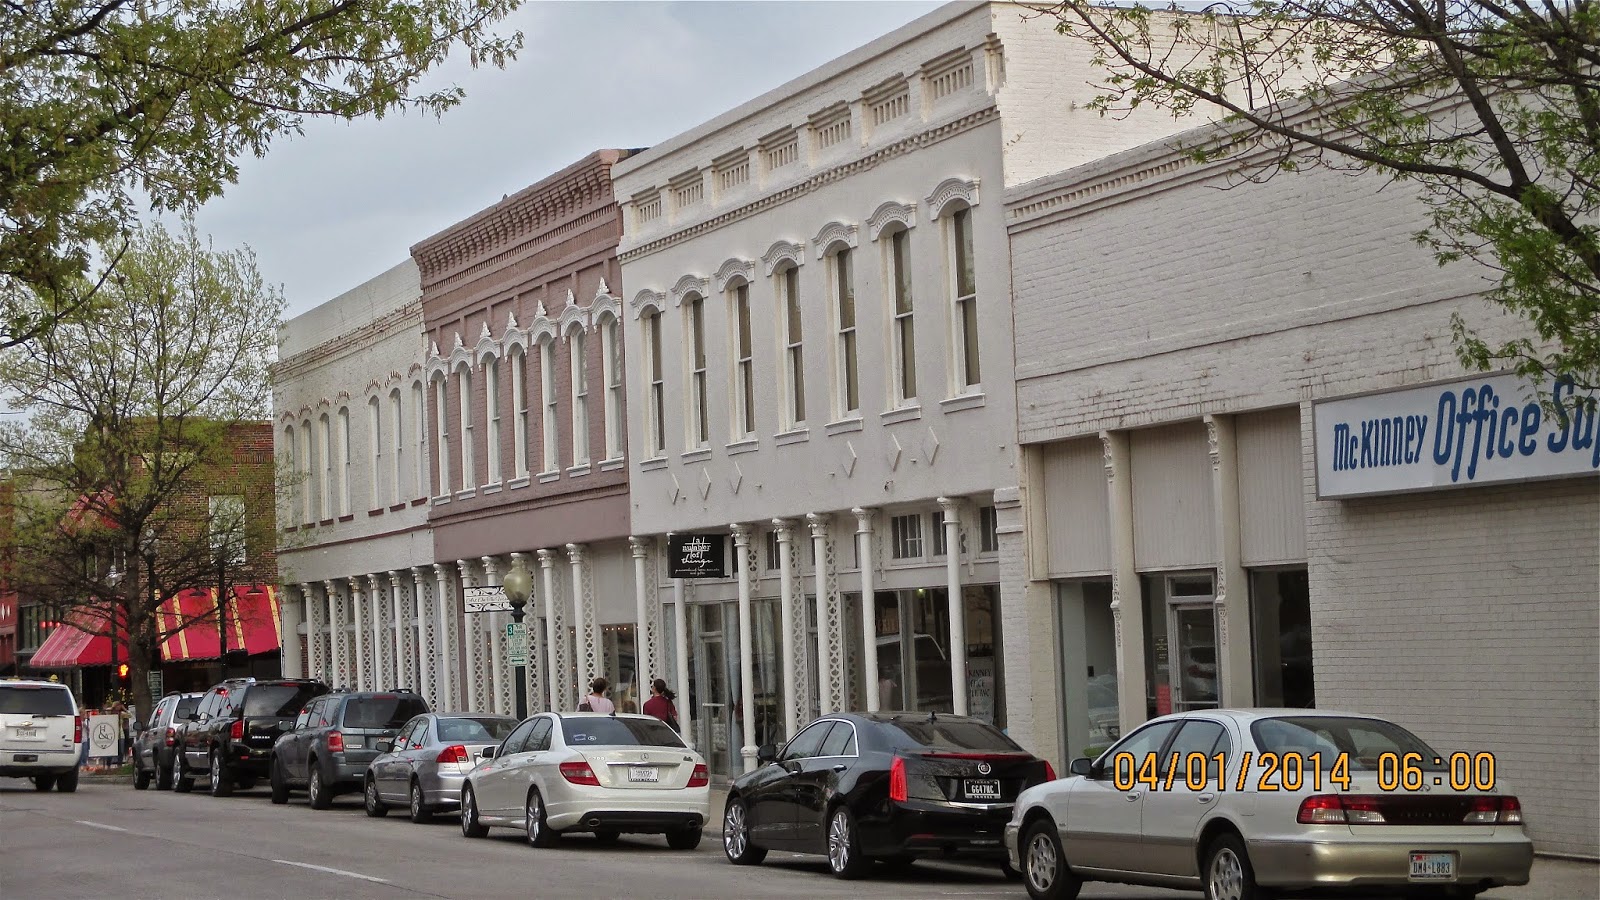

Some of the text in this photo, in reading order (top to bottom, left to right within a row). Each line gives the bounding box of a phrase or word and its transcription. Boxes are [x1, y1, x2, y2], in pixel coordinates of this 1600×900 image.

[1433, 384, 1541, 482] Office
[681, 553, 713, 568] things
[509, 625, 513, 635] 3
